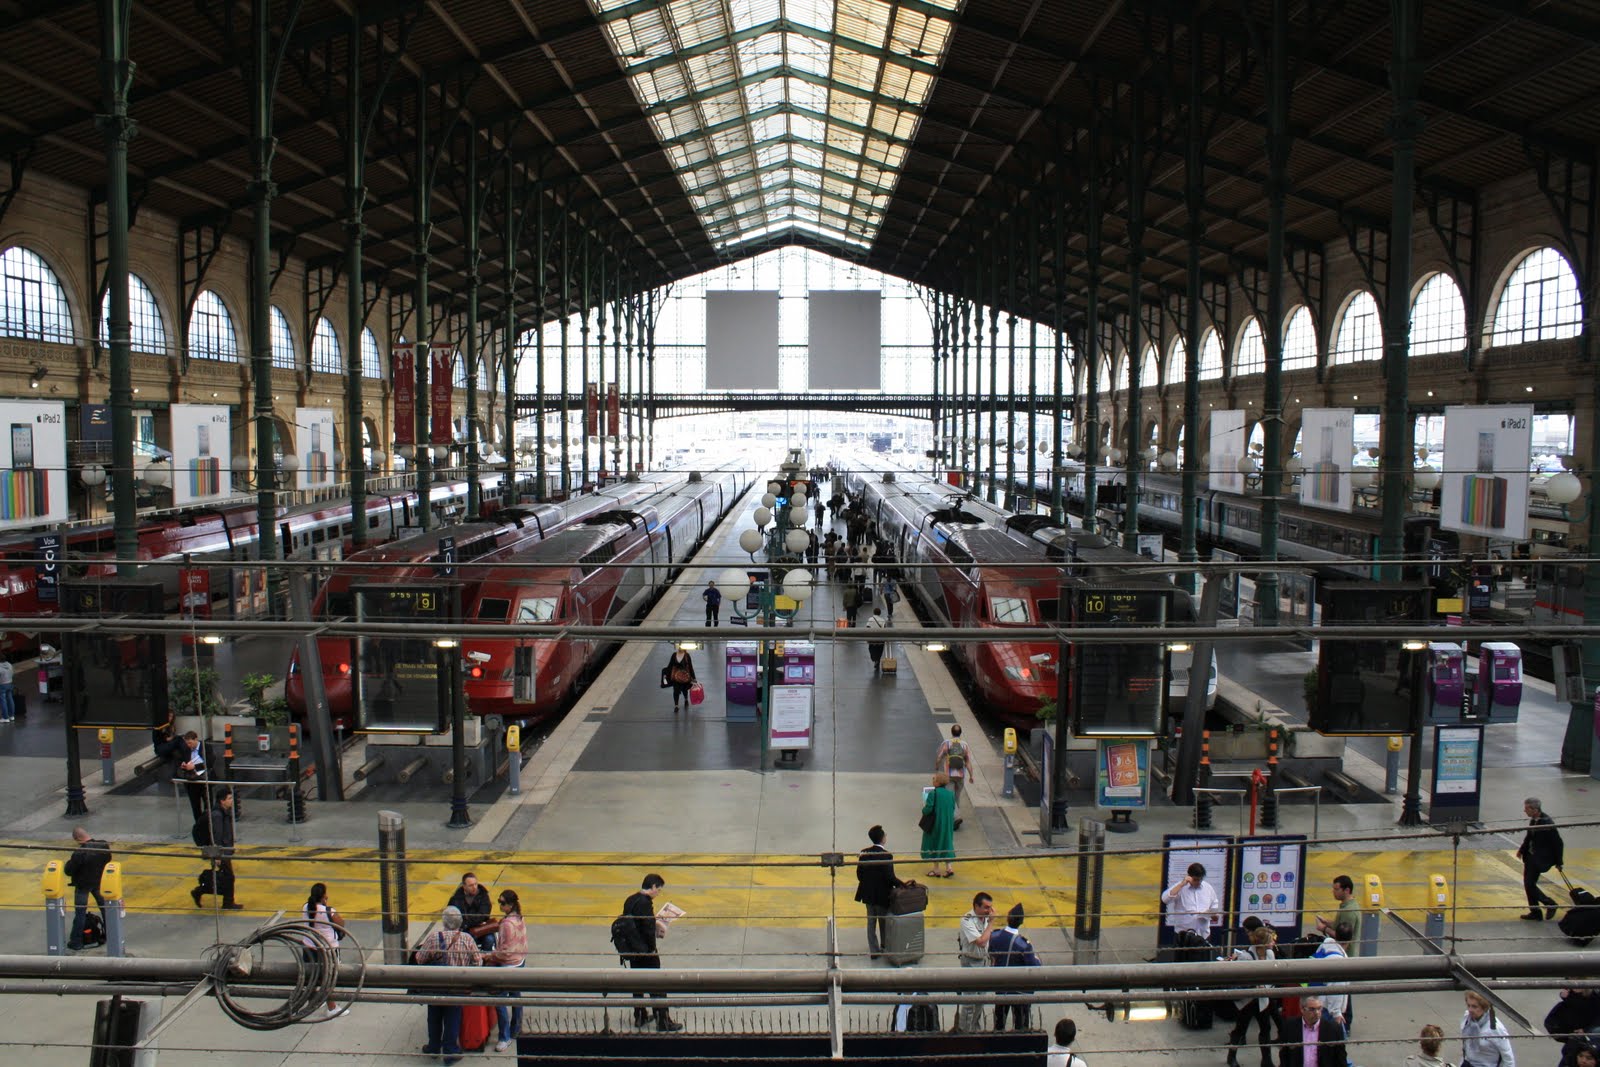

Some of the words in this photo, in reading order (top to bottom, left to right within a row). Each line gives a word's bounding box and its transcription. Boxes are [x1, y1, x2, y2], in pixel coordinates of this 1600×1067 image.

[43, 413, 56, 424] iPad
[1507, 417, 1521, 429] iPad
[43, 537, 55, 545] Voie
[12, 579, 37, 593] THAL
[421, 597, 430, 609] 9
[1088, 600, 1104, 611] 10
